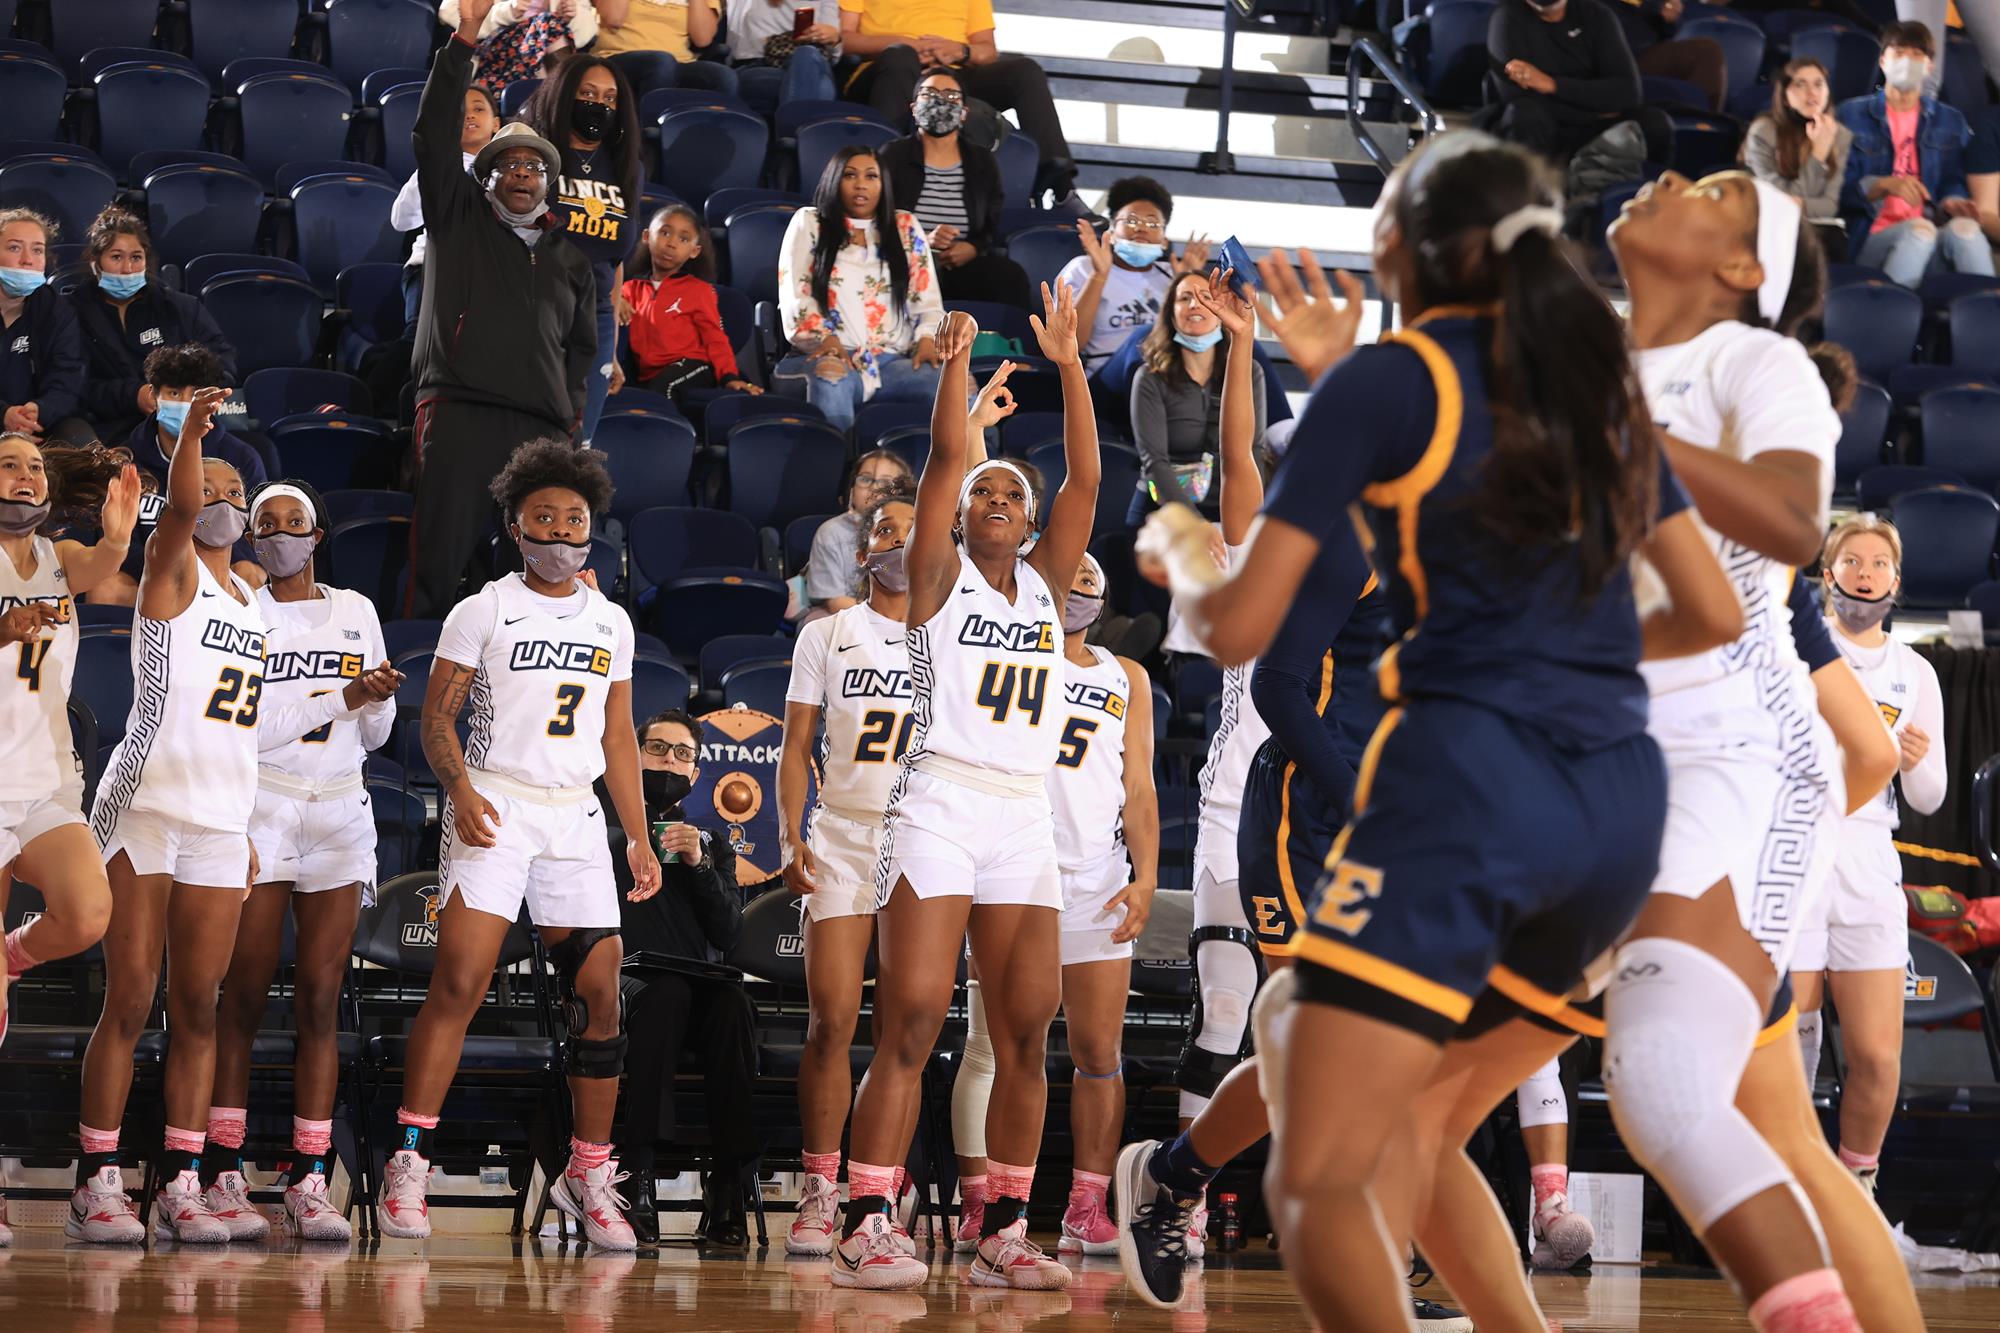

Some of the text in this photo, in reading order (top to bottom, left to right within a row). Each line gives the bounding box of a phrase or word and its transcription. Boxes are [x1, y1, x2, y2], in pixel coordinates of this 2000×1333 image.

[558, 174, 625, 209] UNCG
[566, 211, 620, 240] MOM
[201, 618, 266, 662] UNC
[958, 614, 1054, 654] UNCG
[16, 637, 54, 693] 4
[264, 651, 364, 684] UNCG
[509, 640, 612, 678] UNCG
[202, 665, 263, 730] 23
[842, 668, 912, 699] UNC
[975, 659, 1050, 728] 44
[1064, 682, 1126, 721] NCG
[546, 682, 586, 739] 3
[700, 743, 781, 764] ATTACK
[1055, 715, 1101, 769] 5
[732, 842, 756, 855] CG
[1252, 895, 1286, 937] E
[1314, 859, 1385, 938] E
[401, 923, 438, 947] UN
